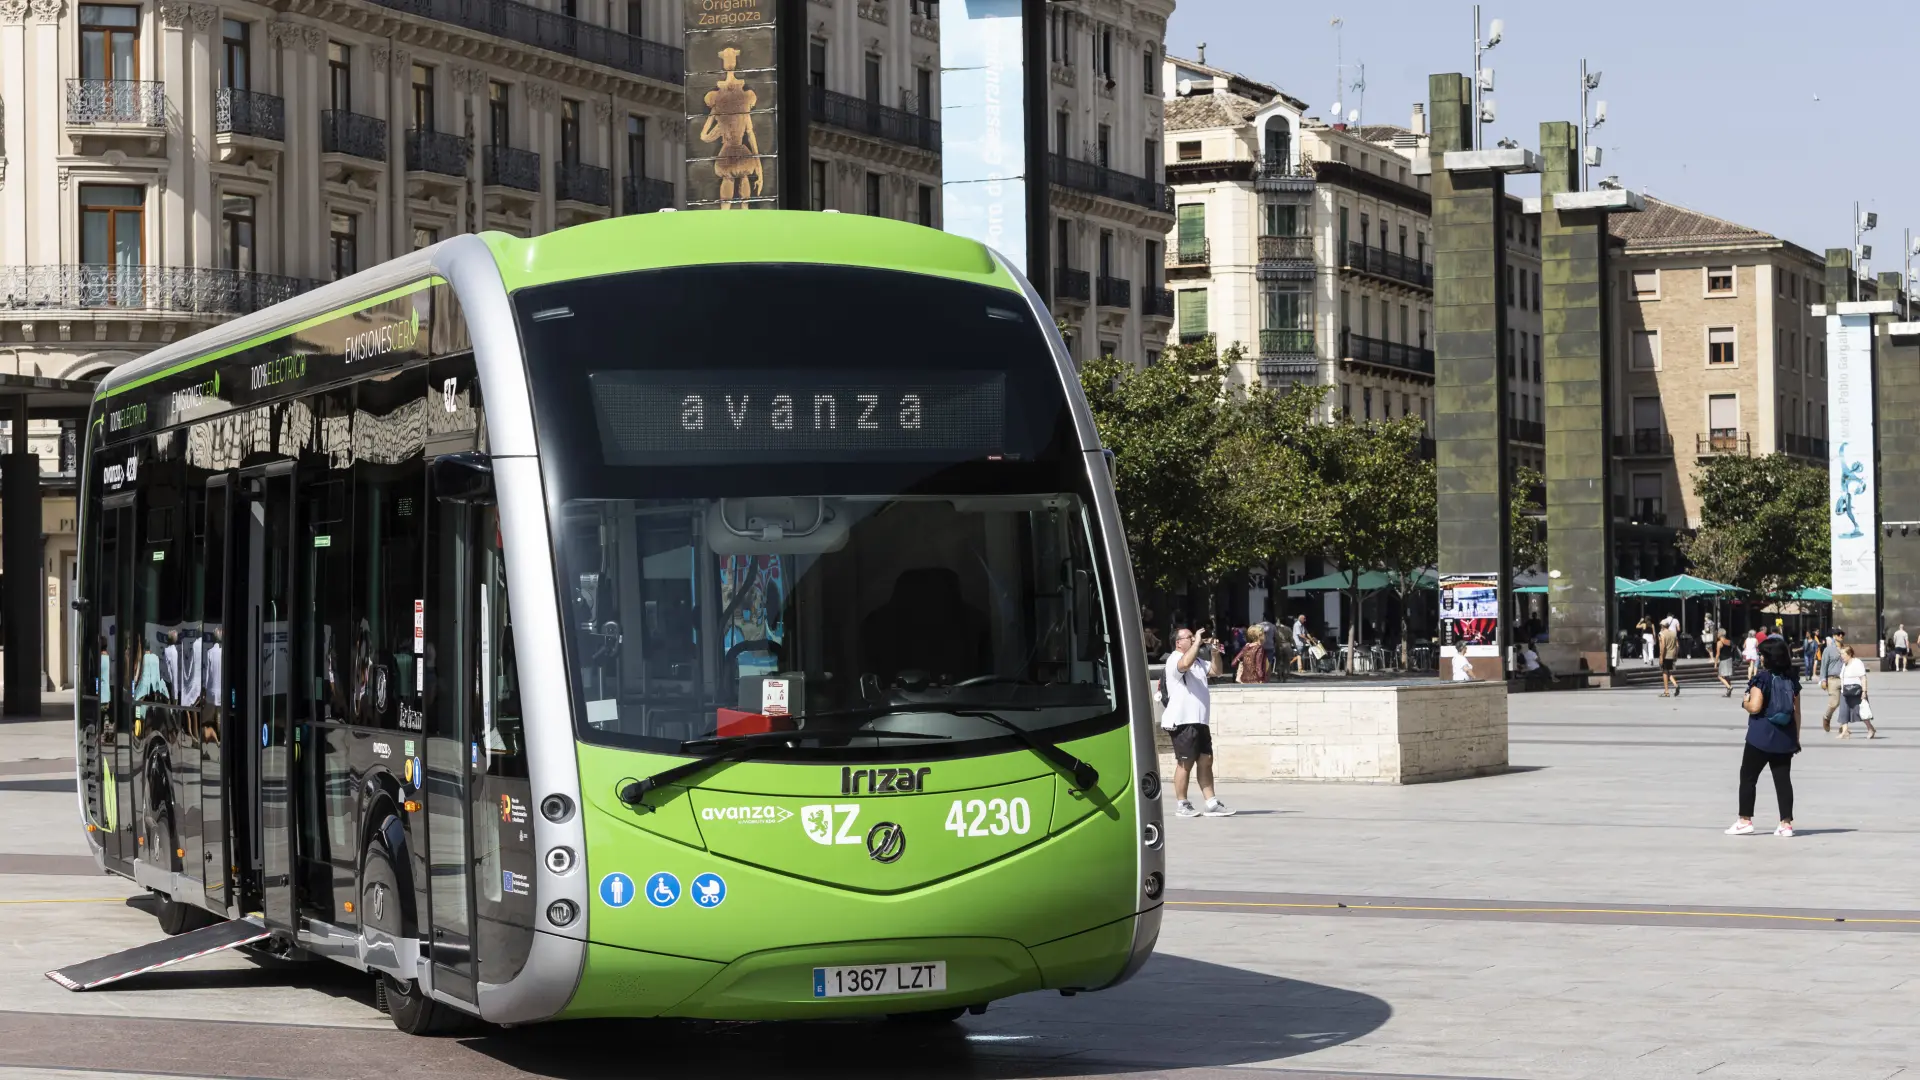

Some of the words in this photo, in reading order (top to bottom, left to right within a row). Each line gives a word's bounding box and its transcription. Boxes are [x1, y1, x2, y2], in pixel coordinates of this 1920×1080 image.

[698, 11, 761, 25] Zaragoza
[702, 0, 756, 12] Origami
[1837, 324, 1850, 370] Gargallo
[1838, 373, 1849, 404] Pablo
[680, 393, 924, 430] avanza
[841, 766, 932, 795] Irizar
[701, 805, 776, 820] avanza
[834, 804, 862, 844] Z
[944, 797, 1032, 838] 4230
[835, 967, 887, 993] 1367
[897, 965, 936, 990] LZT
